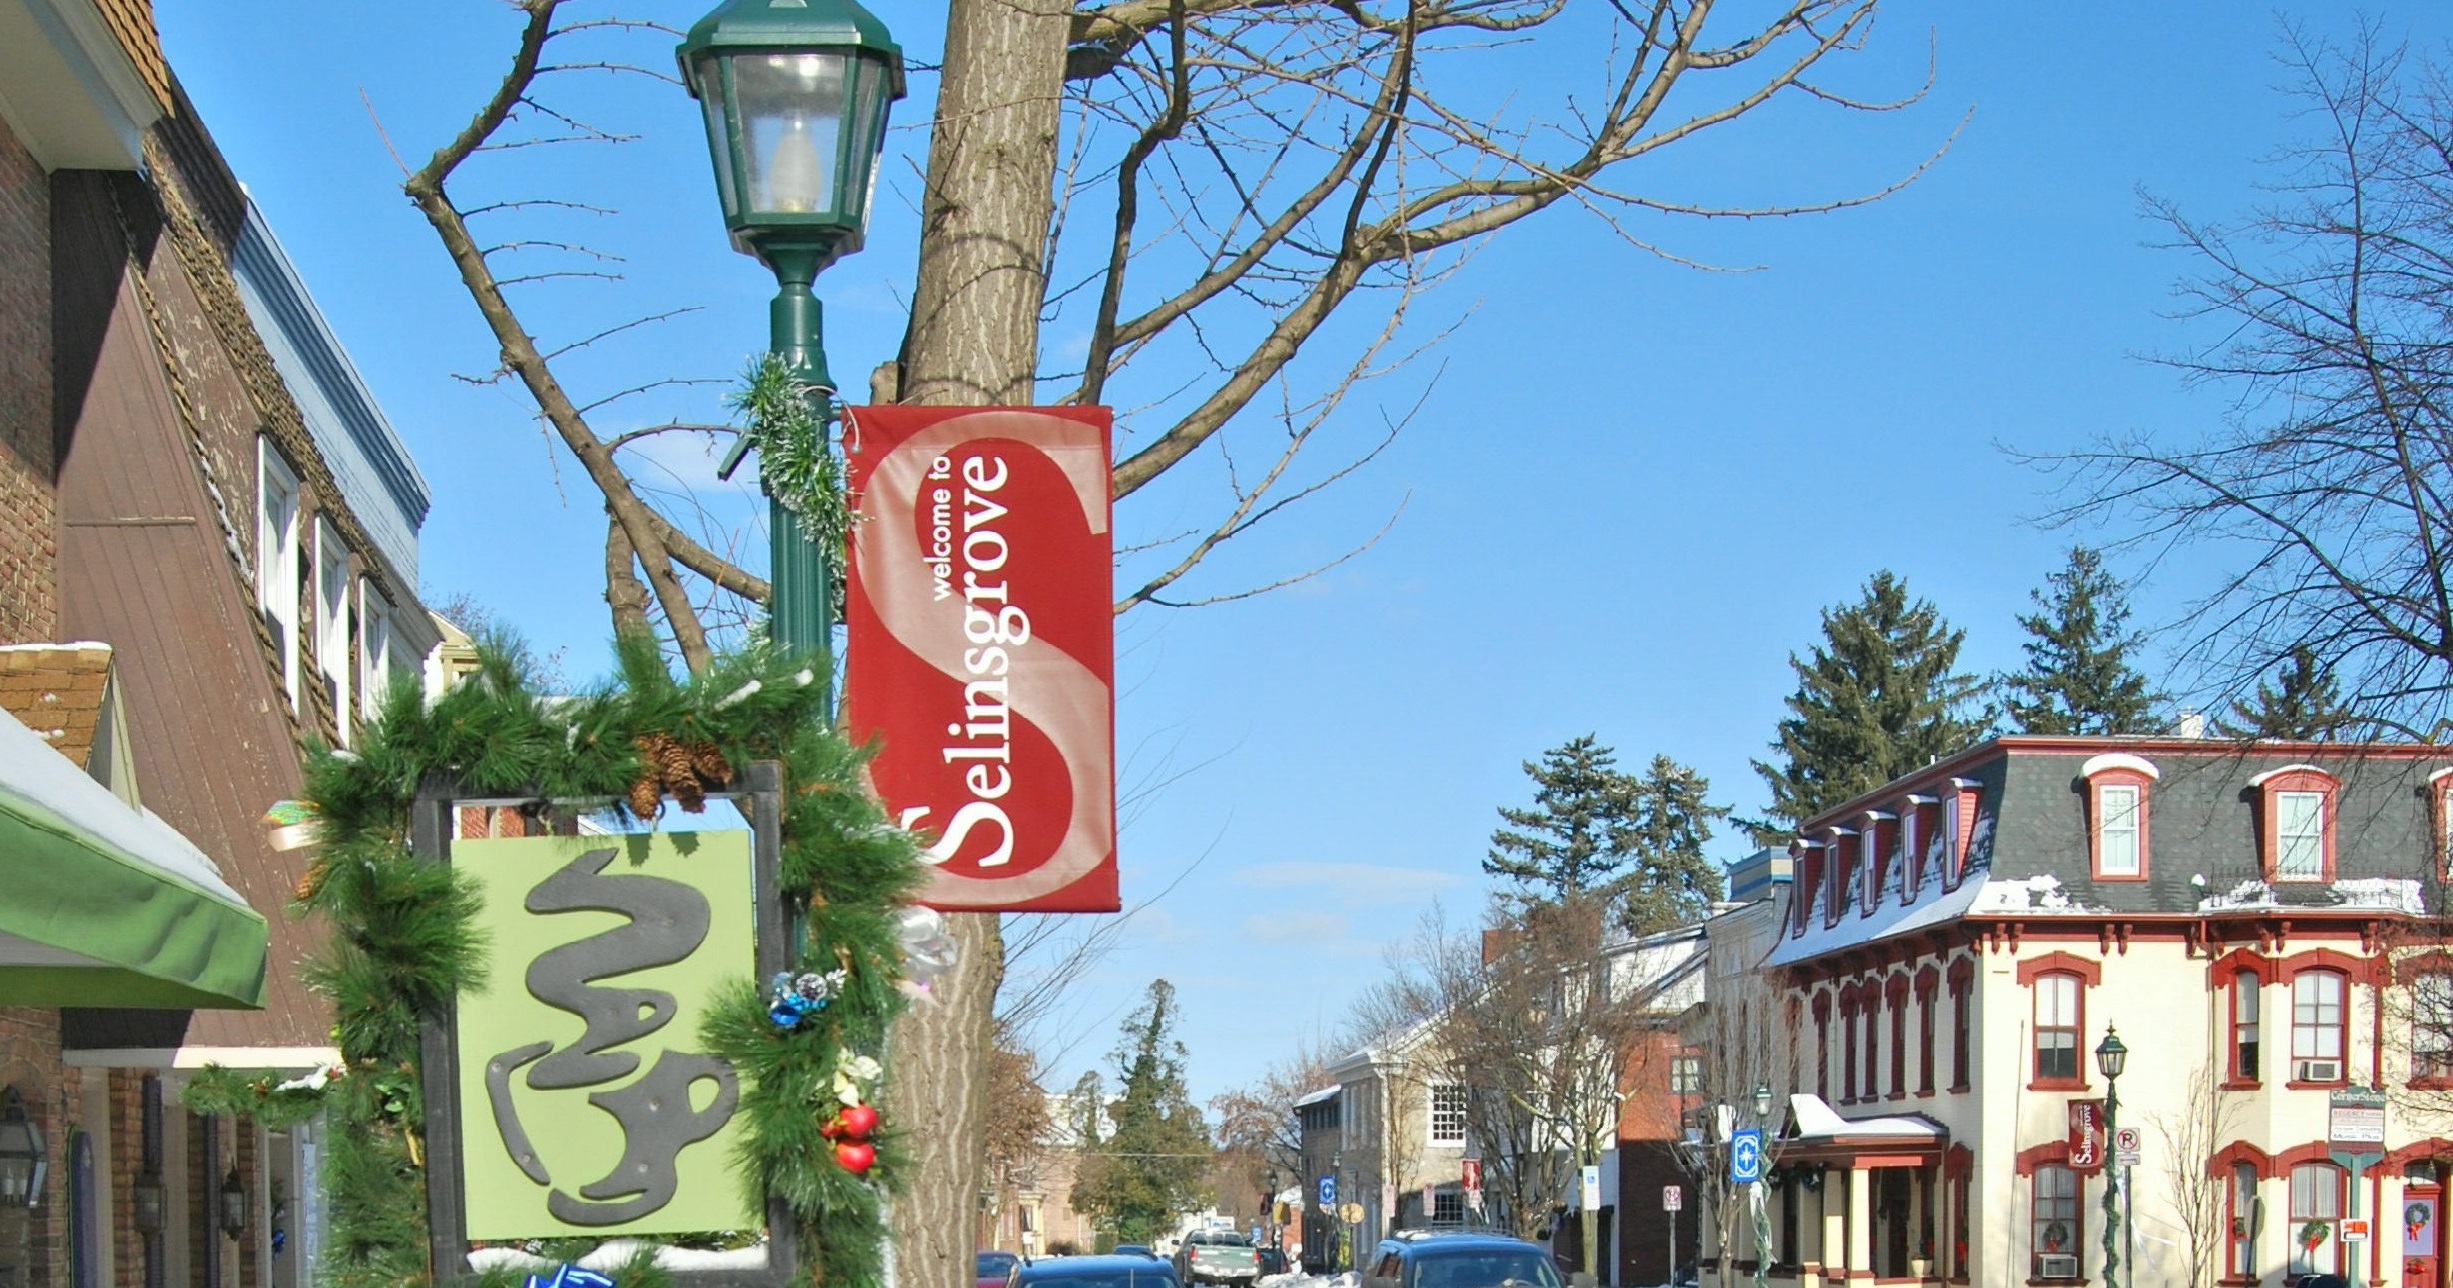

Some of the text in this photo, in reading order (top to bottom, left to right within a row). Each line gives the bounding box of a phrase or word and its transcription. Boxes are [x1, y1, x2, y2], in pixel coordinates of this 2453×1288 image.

[900, 455, 1031, 868] Selinsgrove
[922, 455, 952, 602] welcome to
